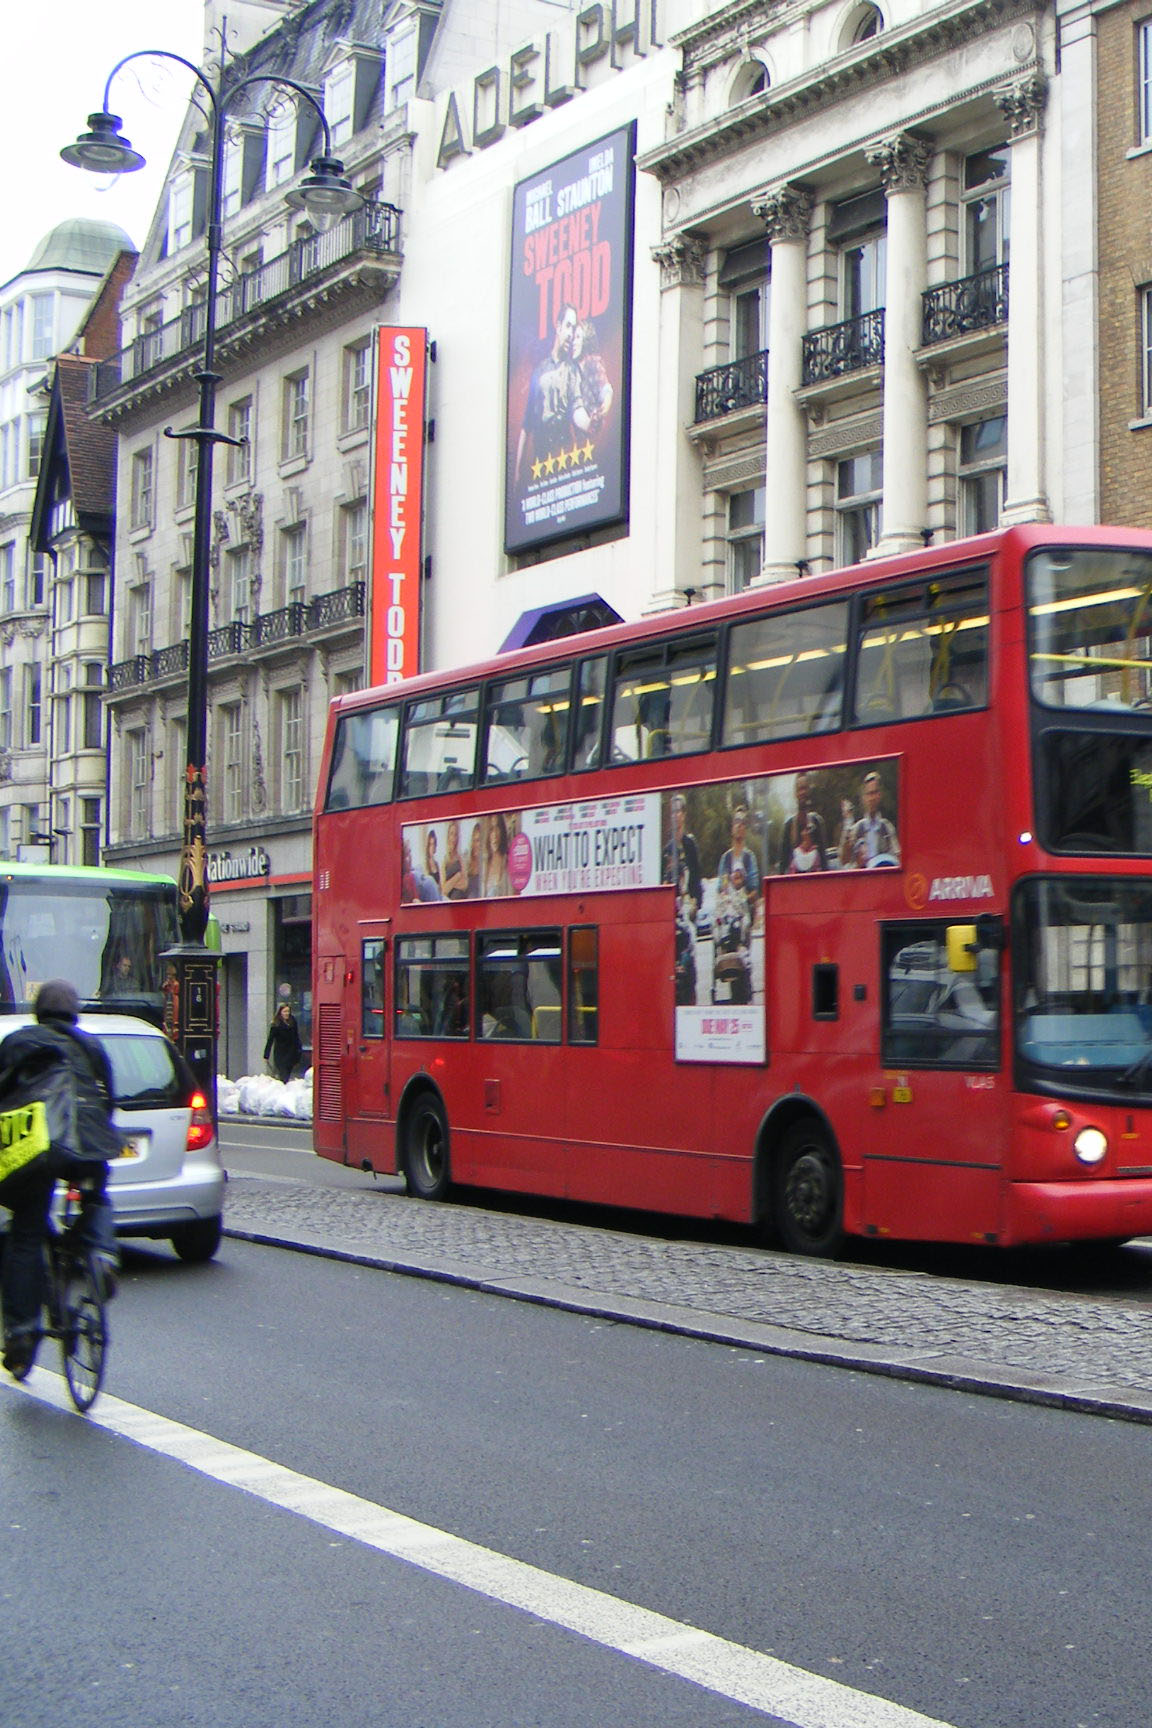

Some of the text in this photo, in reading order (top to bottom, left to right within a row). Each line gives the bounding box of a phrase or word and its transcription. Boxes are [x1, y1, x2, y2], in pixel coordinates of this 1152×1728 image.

[436, 0, 664, 170] ADELPHI
[525, 164, 613, 234] BALL STAUNTON
[523, 200, 602, 276] SWEENEY
[535, 240, 612, 340] TODD
[388, 334, 413, 561] SWEENEY
[534, 832, 571, 873] WHAT
[571, 831, 590, 869] TO
[594, 824, 645, 867] EXPECT
[535, 871, 559, 892] WHEN
[594, 863, 643, 888] EXPECTING
[929, 874, 994, 900] ARRIVA
